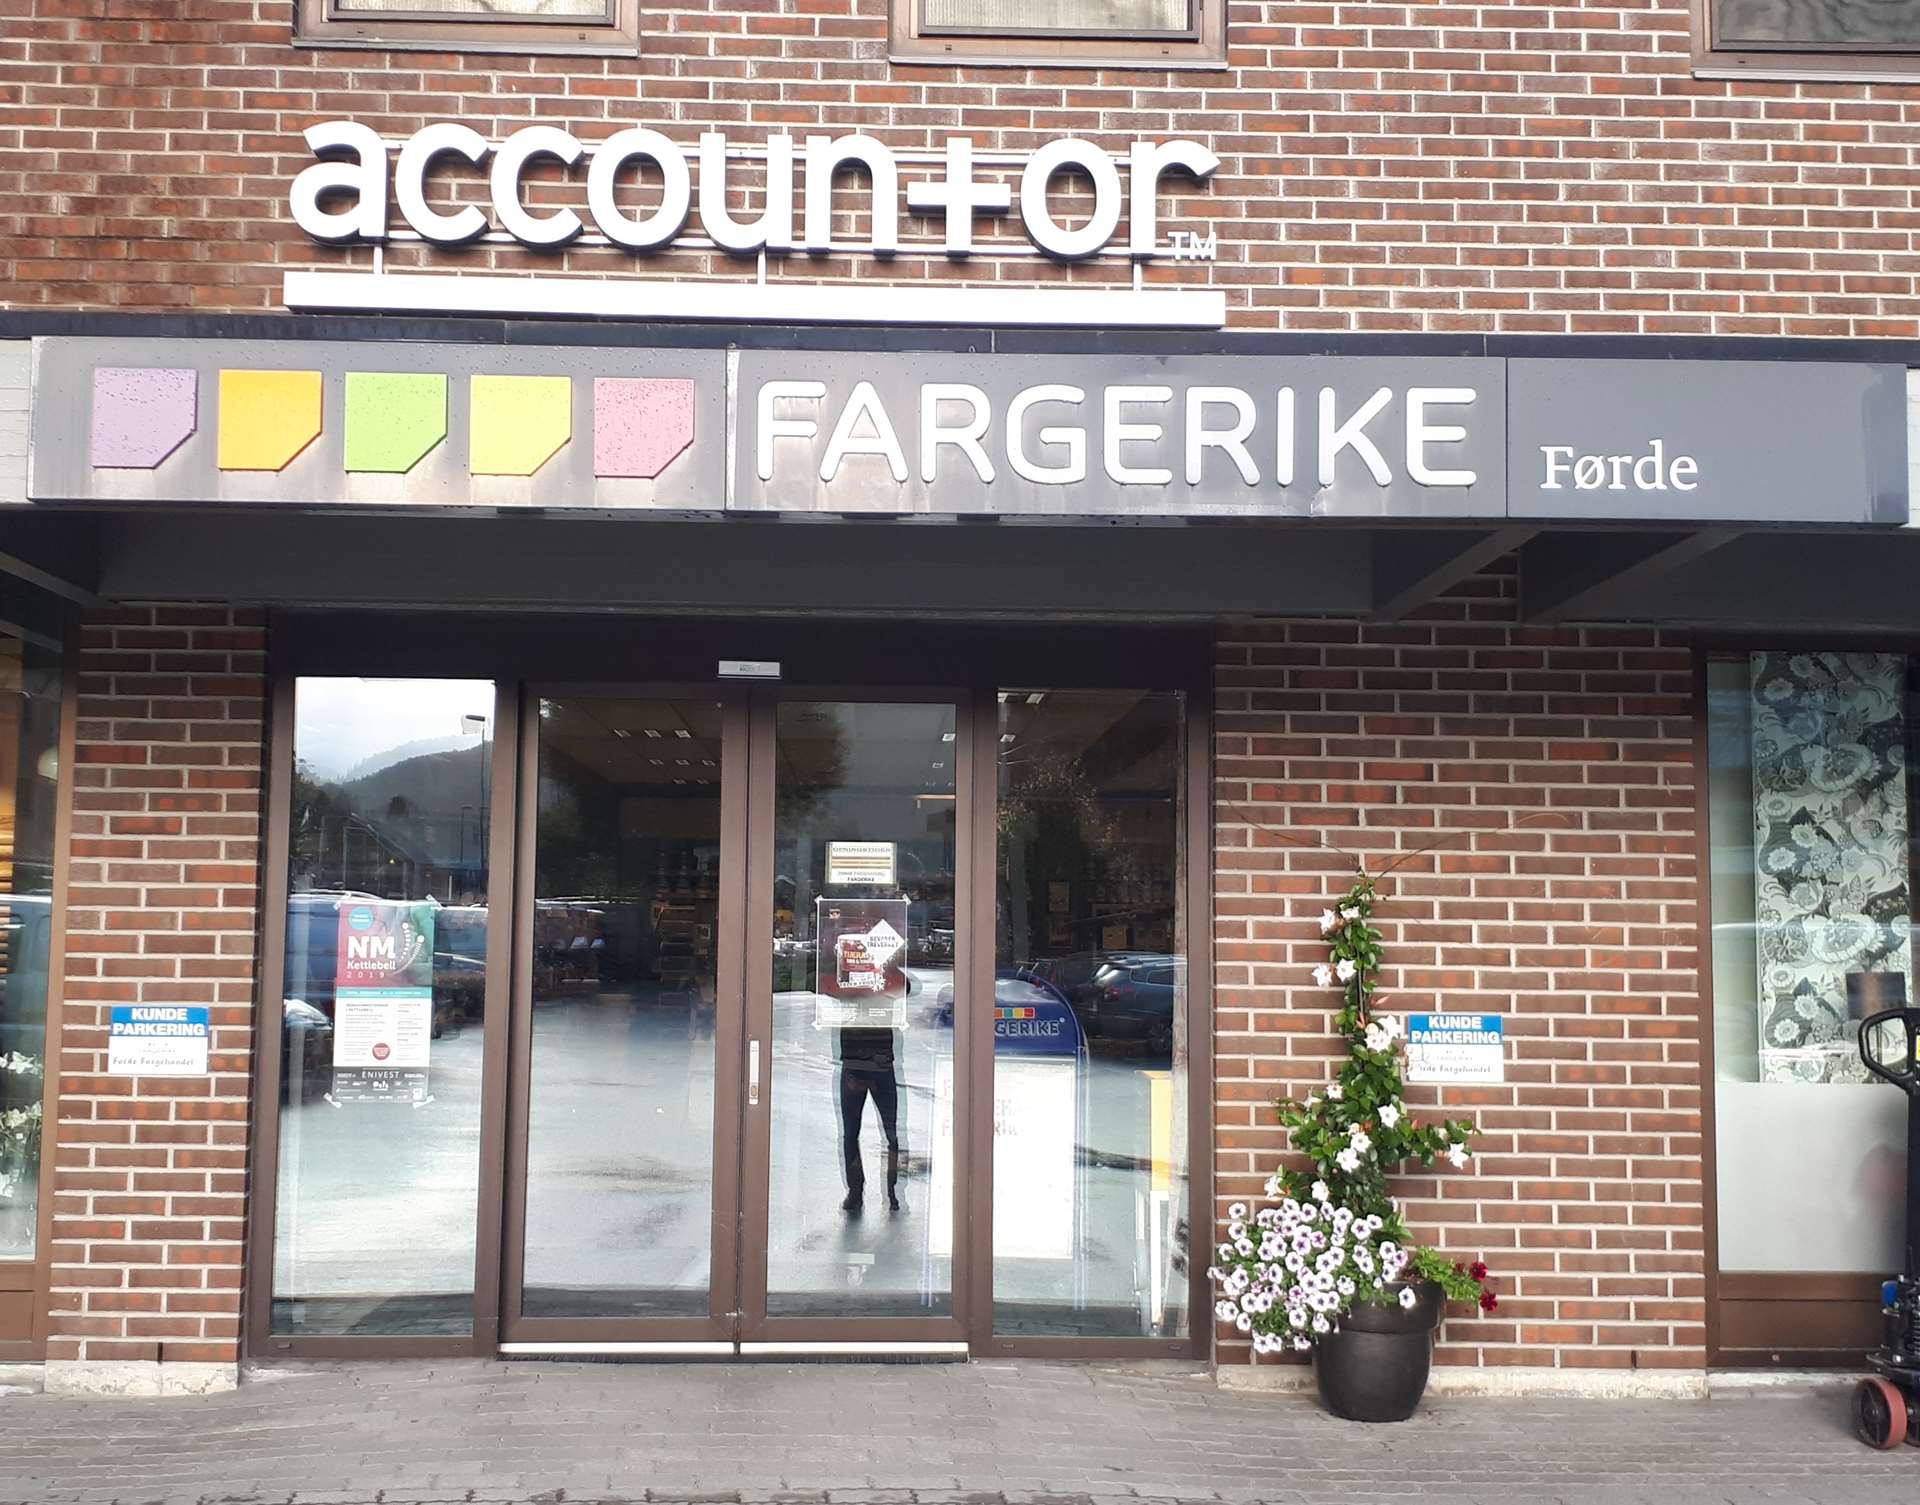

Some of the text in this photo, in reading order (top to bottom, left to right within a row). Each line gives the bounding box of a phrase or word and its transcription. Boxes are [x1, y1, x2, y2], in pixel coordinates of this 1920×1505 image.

[757, 381, 1699, 491] FARGERIKE Førde
[348, 935, 395, 959] NM
[347, 959, 397, 970] Kettlebell
[131, 1007, 188, 1021] KUNDE
[112, 1023, 205, 1036] PARKERING
[994, 1020, 1060, 1037] GERIKE
[1428, 1016, 1482, 1029] KUNDE
[1411, 1030, 1501, 1044] PARKERING
[361, 1071, 400, 1079] ENIVEST
